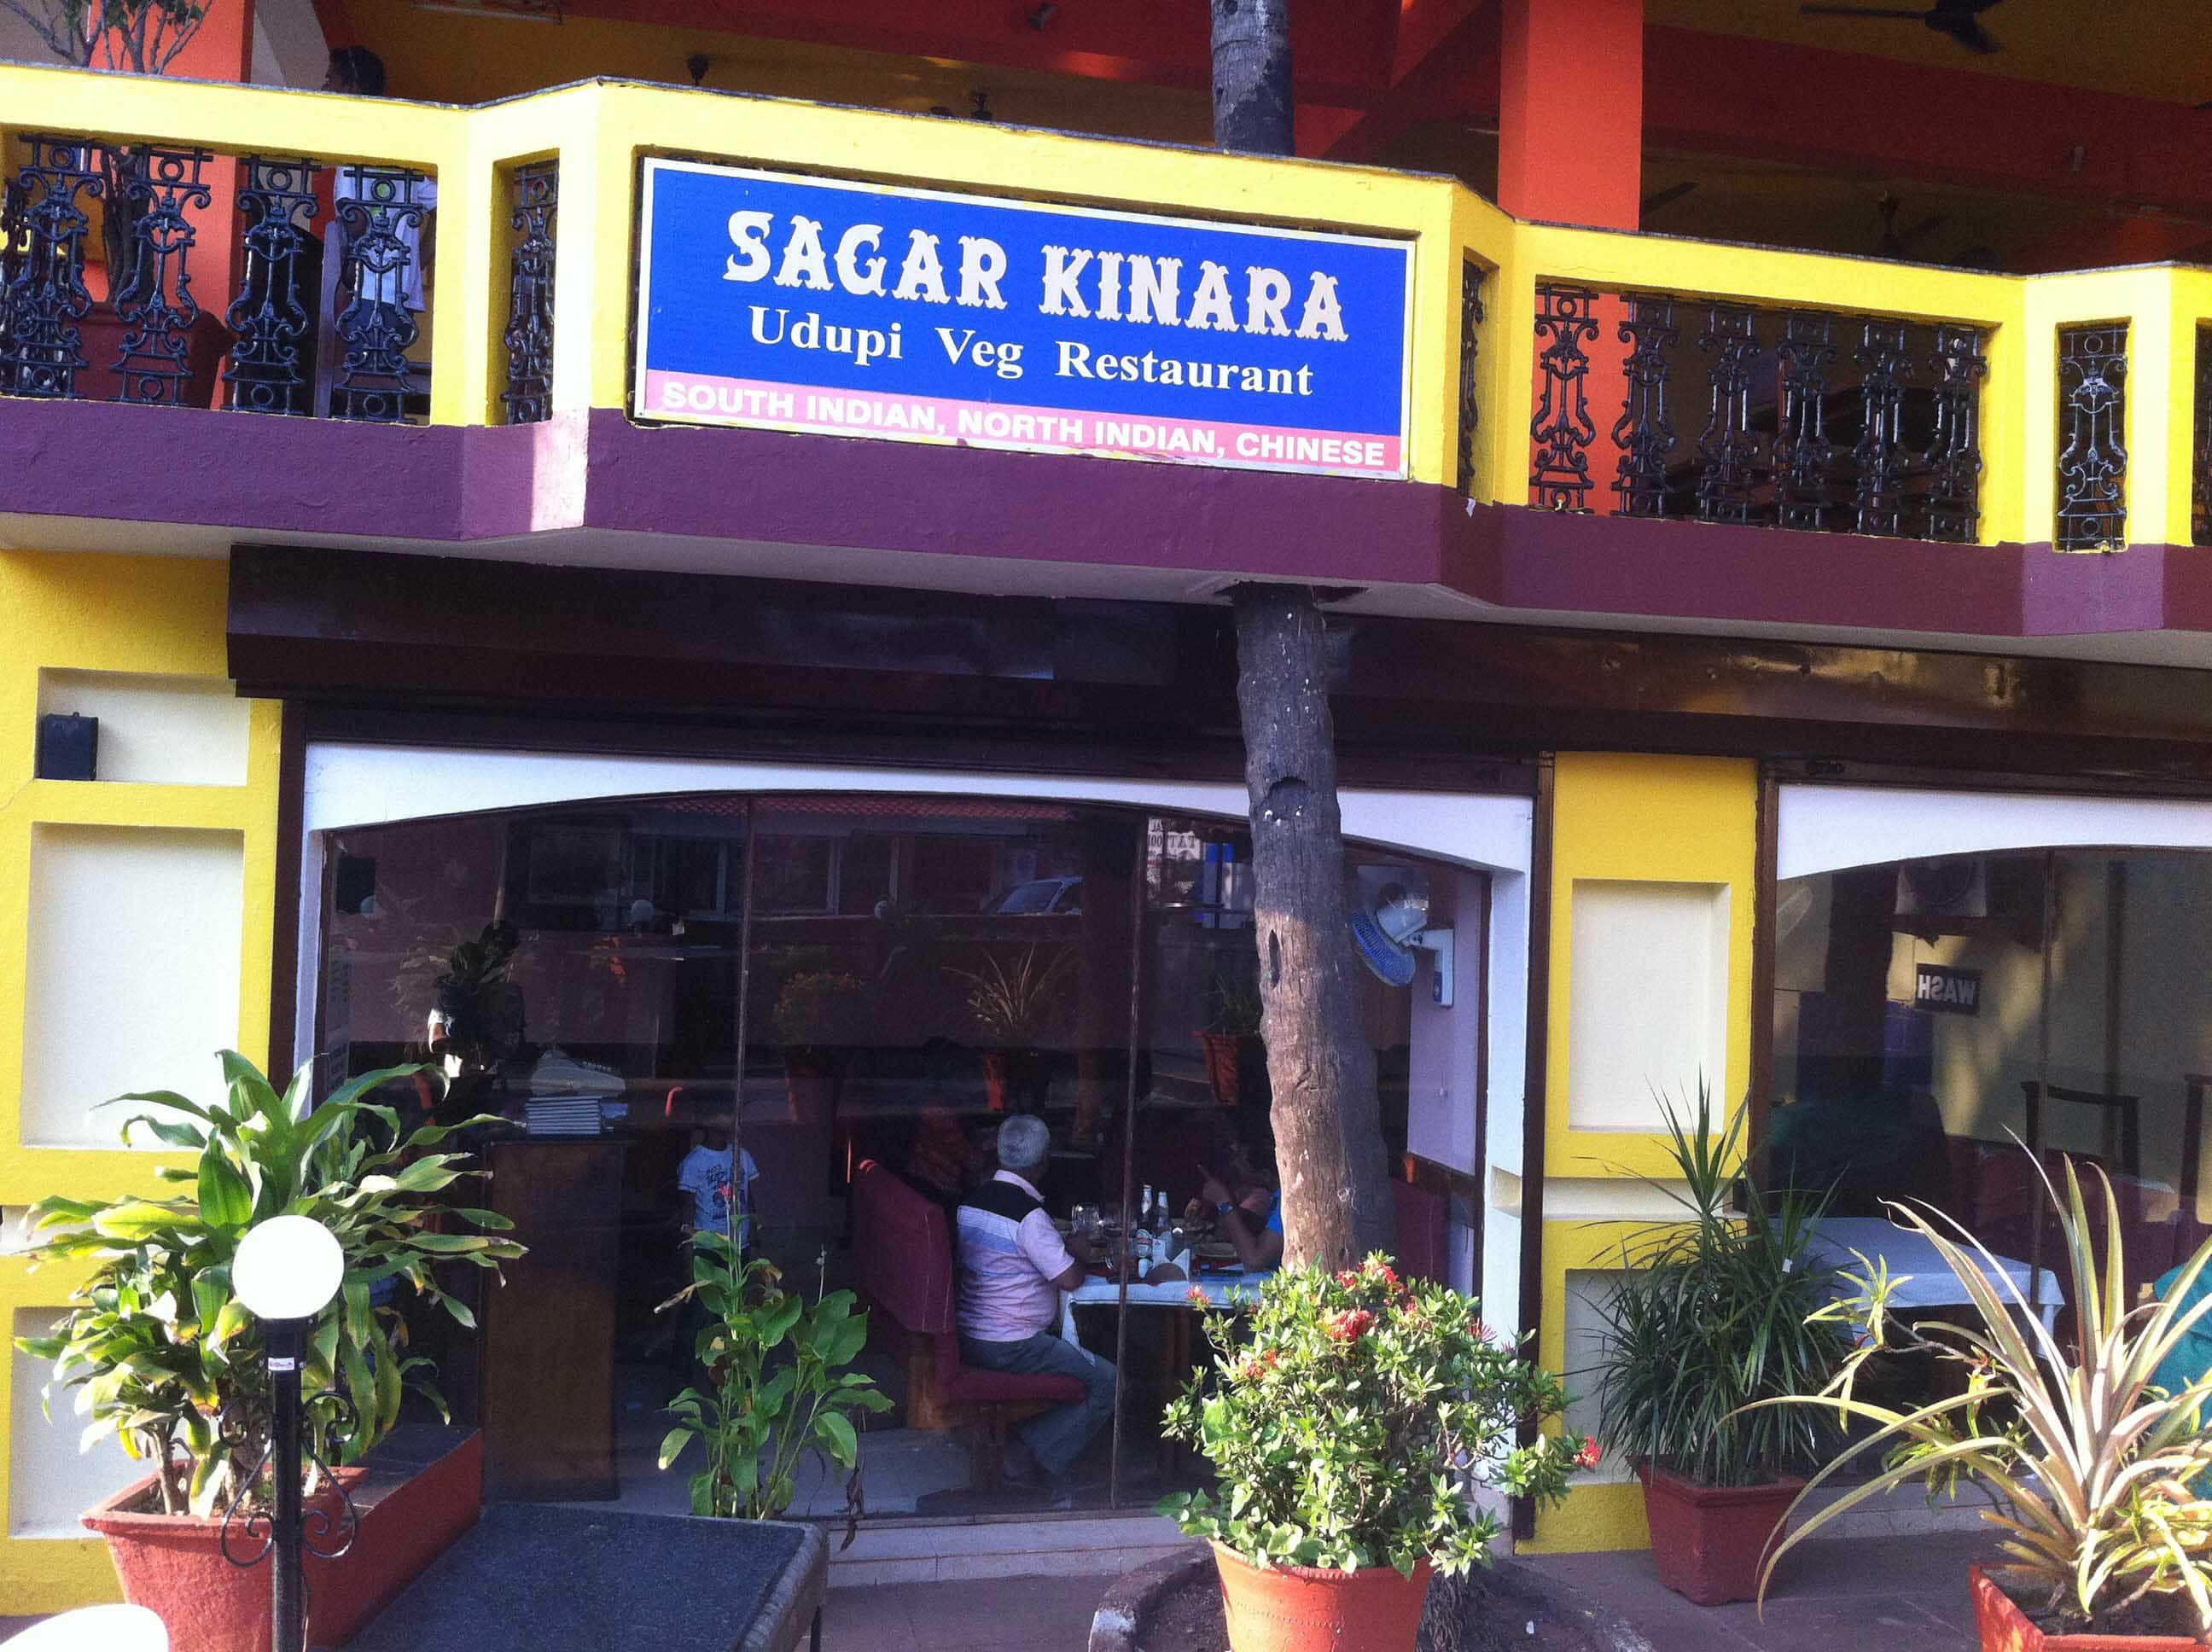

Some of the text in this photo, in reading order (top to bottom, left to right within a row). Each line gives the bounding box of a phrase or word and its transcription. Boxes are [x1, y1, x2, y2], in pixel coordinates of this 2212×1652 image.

[723, 210, 1349, 341] SAGAR KINARA
[748, 305, 1314, 396] Udupi Veg Restaurant
[661, 381, 1385, 467] SOUTH INDIAN, NORTH INDIAN, CHINESE
